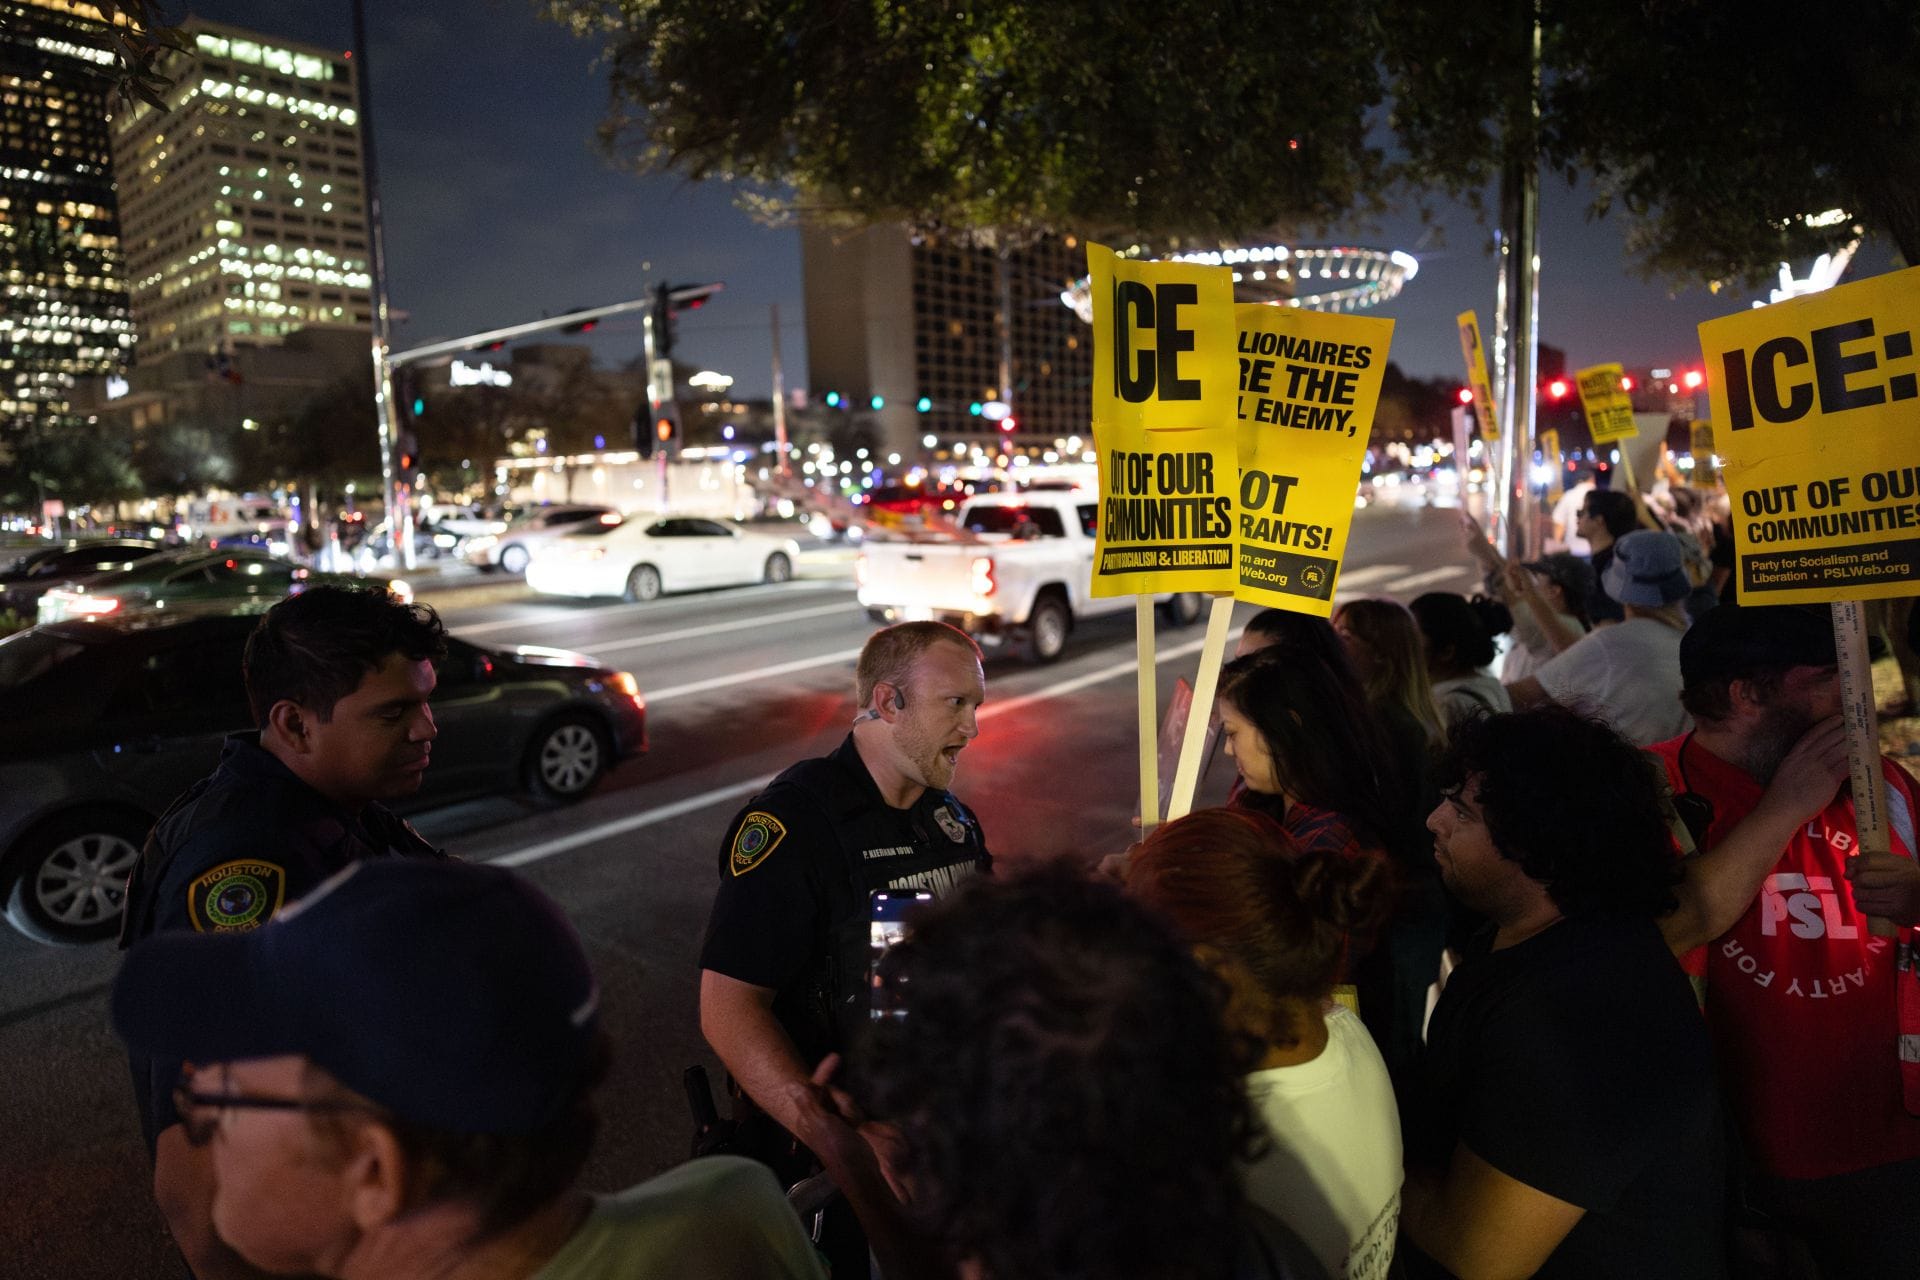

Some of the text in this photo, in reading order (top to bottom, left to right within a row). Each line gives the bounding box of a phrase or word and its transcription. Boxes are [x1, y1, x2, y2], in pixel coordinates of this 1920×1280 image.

[1113, 274, 1202, 403] ICE
[1238, 331, 1372, 369] LIONAIRES
[1239, 358, 1359, 405] RE THE
[1722, 317, 1918, 431] ICE:
[1255, 398, 1356, 437] ENEMY,
[1127, 452, 1153, 495] OF
[1157, 452, 1214, 495] OUR
[1239, 468, 1299, 515] OT
[1743, 484, 1798, 517] OUT
[1807, 477, 1850, 509] OF
[1240, 513, 1333, 551] RANTS!
[1158, 551, 1172, 566] &
[1172, 549, 1230, 567] LIBERATION
[1240, 564, 1288, 586] Web.org
[1254, 556, 1276, 568] and
[1751, 549, 1889, 573] Party for Socialism and
[1752, 562, 1910, 584] Liberation PSLWeb.org
[748, 815, 781, 833] HOUSTON
[201, 864, 272, 888] HOUSTON
[1761, 890, 1859, 939] PSL
[1722, 939, 1776, 988] FOR
